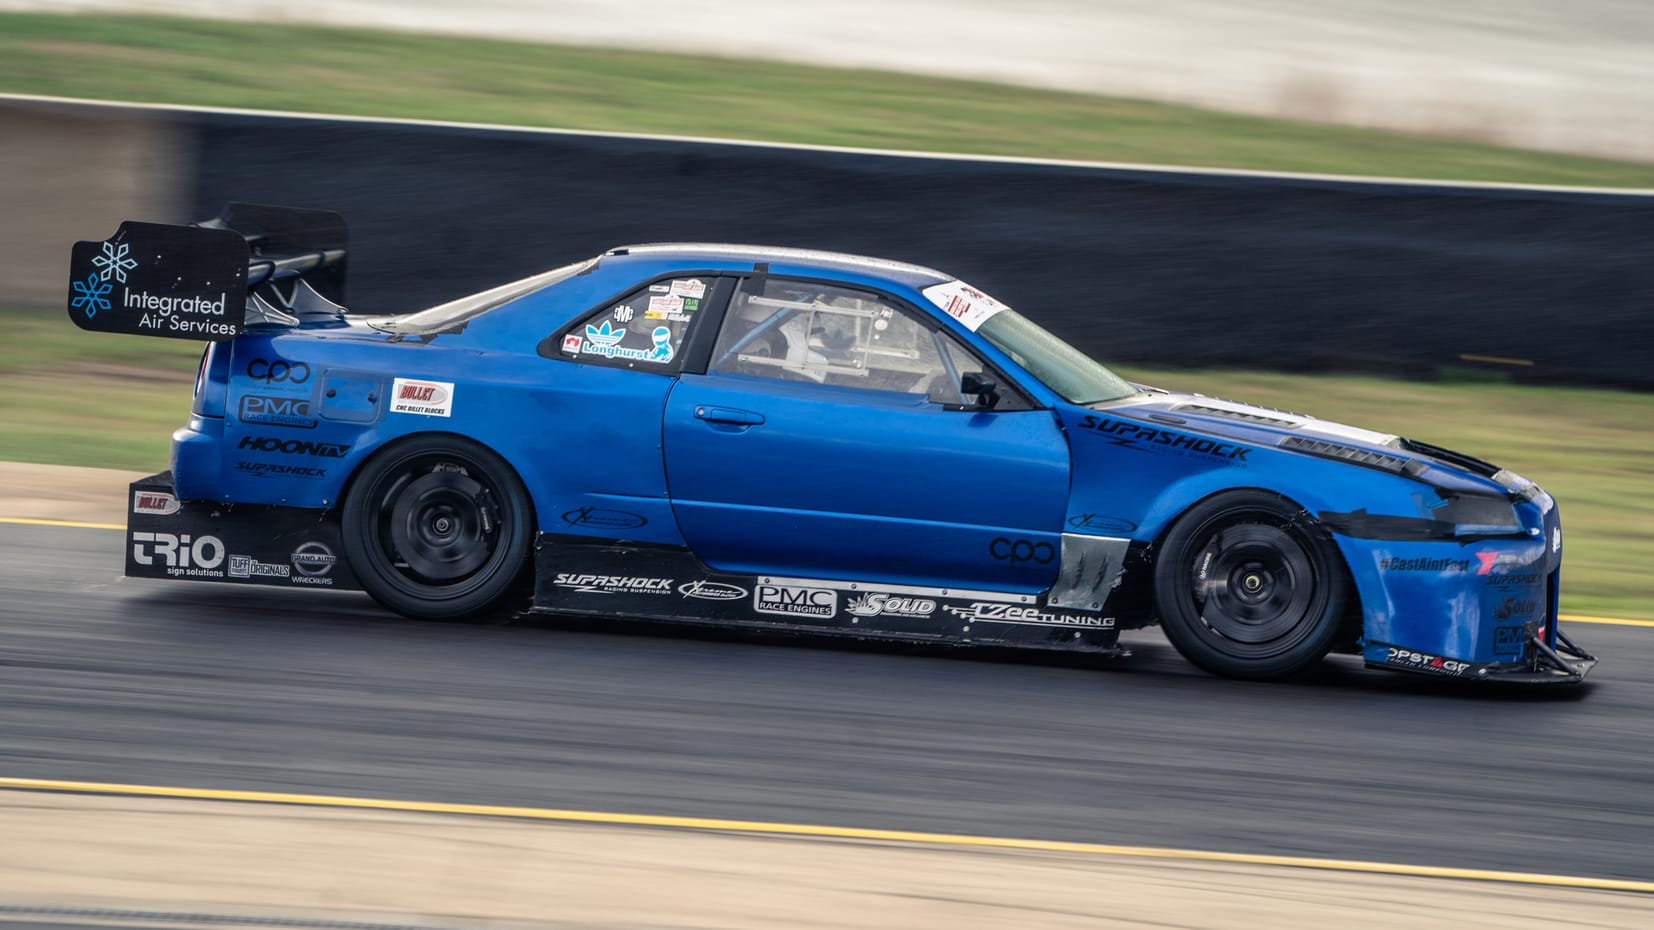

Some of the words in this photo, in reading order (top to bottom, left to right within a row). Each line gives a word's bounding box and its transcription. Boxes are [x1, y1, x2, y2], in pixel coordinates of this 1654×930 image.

[123, 287, 226, 317] Integrated
[139, 314, 163, 329] Air
[169, 316, 236, 336] Services
[583, 343, 649, 359] Longhurst
[400, 385, 435, 401] BULLET
[1078, 414, 1253, 462] SUPASHOCK
[234, 461, 327, 477] SUPASHOCK
[167, 566, 185, 577] sign
[185, 568, 224, 577] solutions
[291, 576, 333, 585] WRECKERS
[553, 573, 674, 590] SUPASHOCK
[759, 586, 832, 607] PMC
[760, 602, 785, 611] RACE
[787, 604, 832, 615] ENGINES
